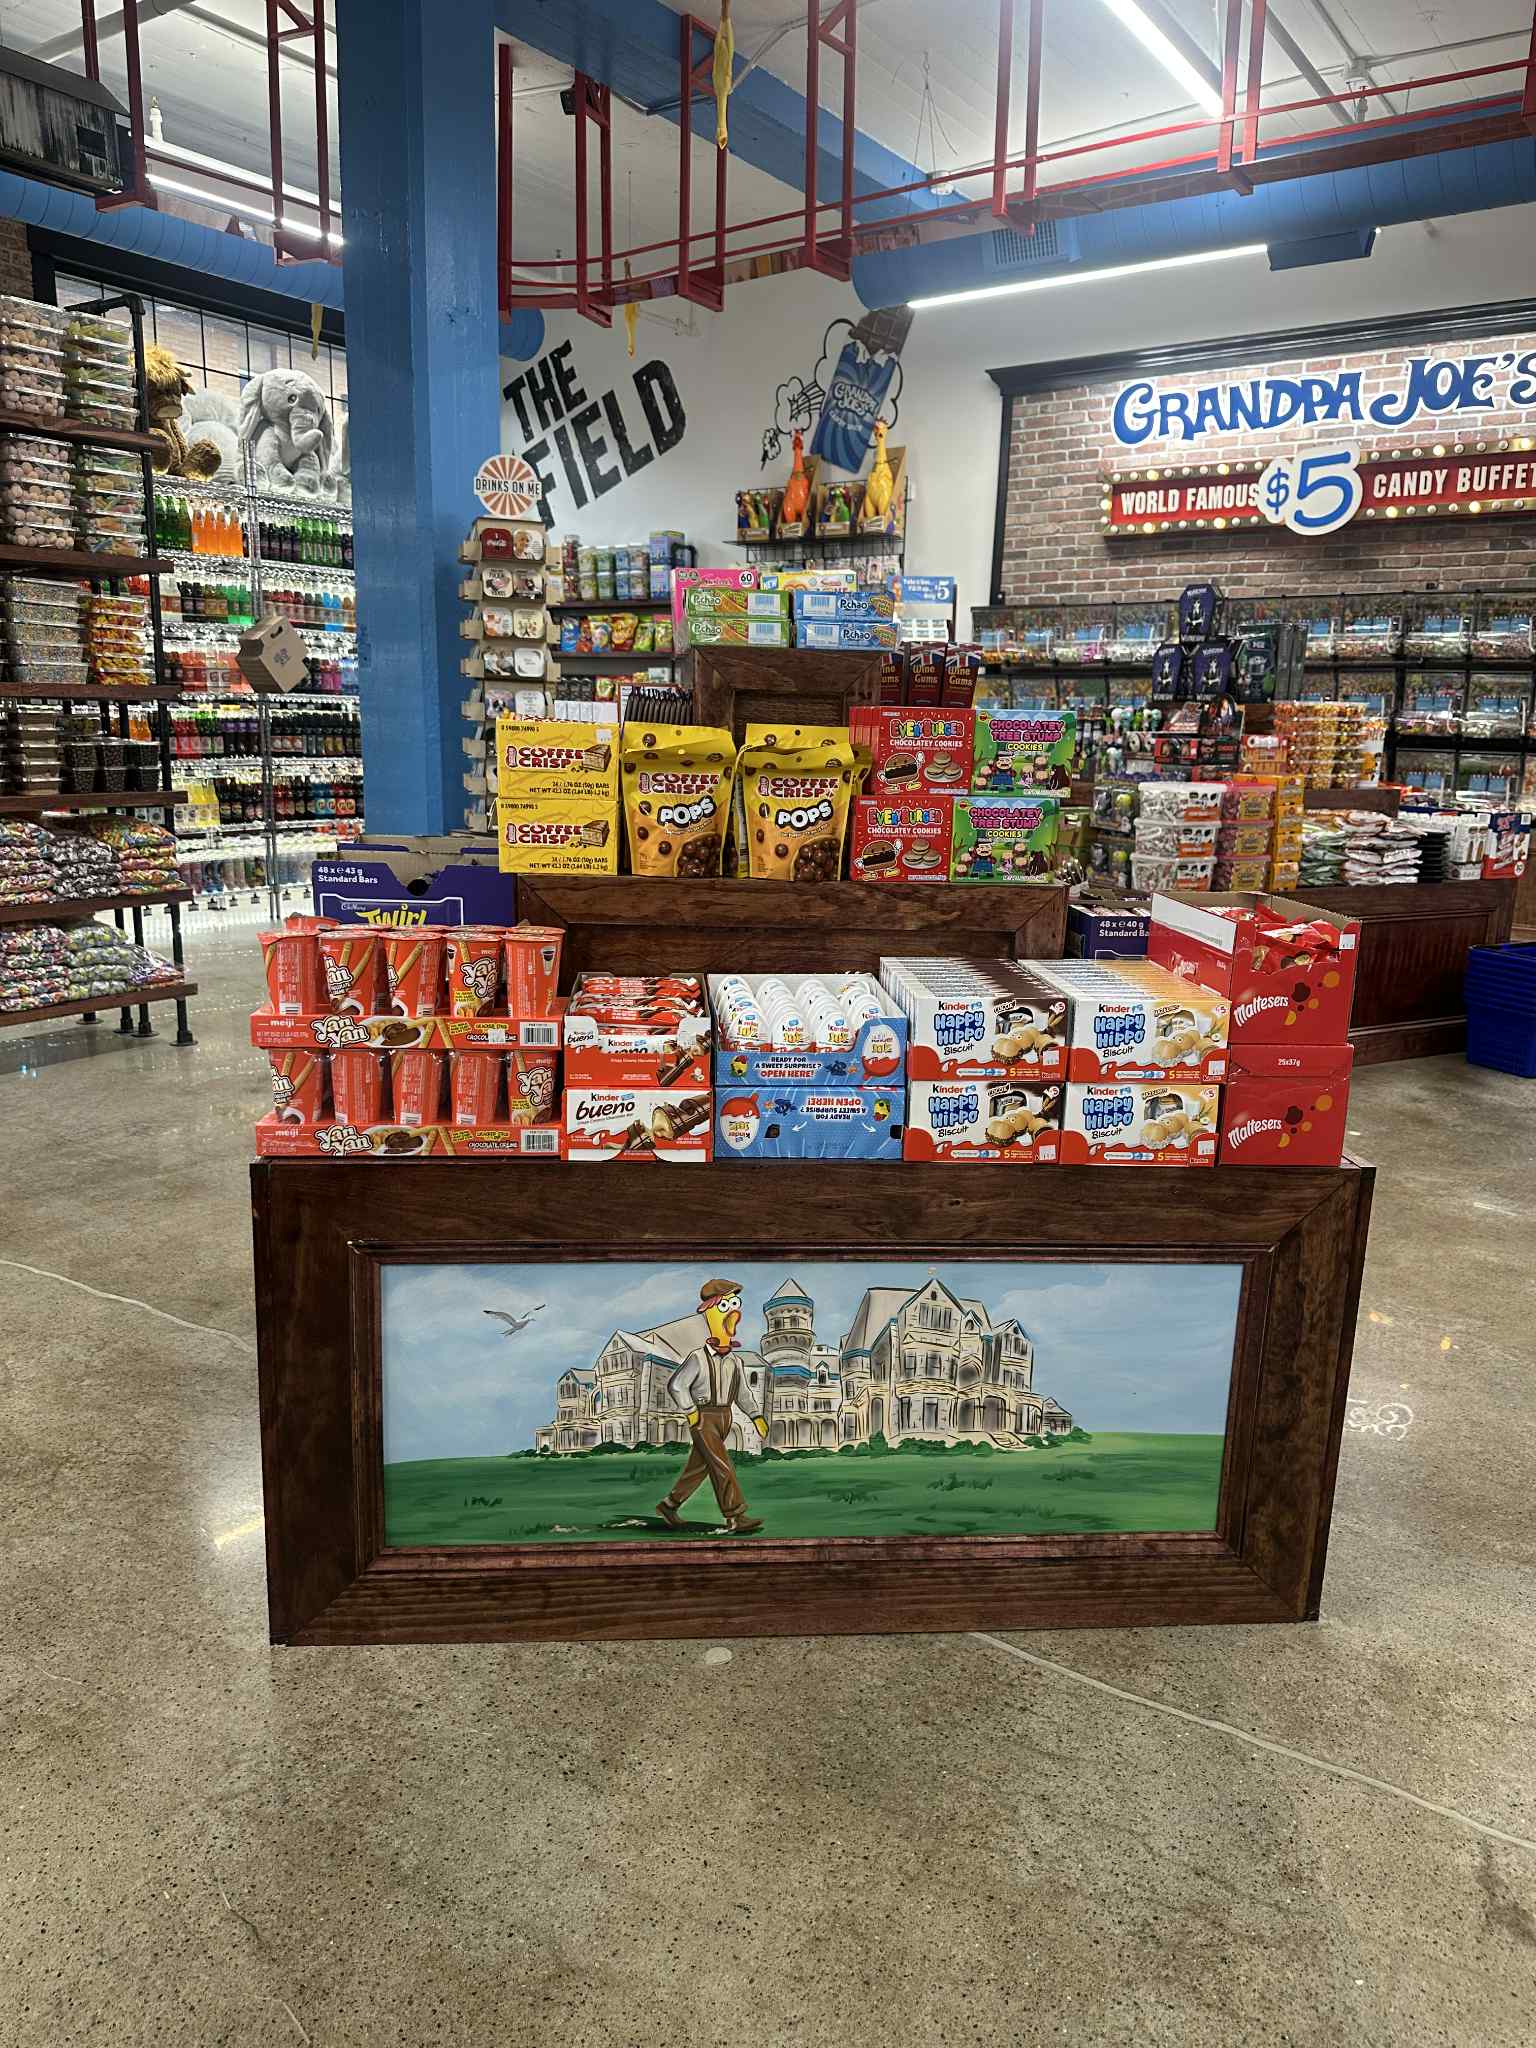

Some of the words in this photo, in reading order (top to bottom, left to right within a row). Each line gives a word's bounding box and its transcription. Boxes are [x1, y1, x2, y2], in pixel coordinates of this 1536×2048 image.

[503, 339, 587, 443] THE
[1113, 373, 1365, 444] GRANDPA
[1370, 352, 1536, 426] JOE'S
[521, 360, 686, 531] FIELD
[476, 479, 509, 492] DRINKS
[512, 481, 524, 493] ON
[528, 482, 540, 495] ME
[1121, 489, 1180, 515] WORLD
[1186, 483, 1259, 512] FAMOUS
[1265, 451, 1351, 528] $5
[1373, 469, 1448, 498] CANDY
[1456, 461, 1536, 494] BUFFET
[741, 573, 752, 582] 60
[882, 665, 896, 673] ine
[912, 665, 935, 674] Wine
[948, 666, 971, 676] Wine
[881, 676, 900, 684] ums
[914, 675, 938, 684] Gums
[949, 676, 973, 686] Gums
[990, 720, 1063, 731] CHOCOLATEY
[992, 731, 1021, 742] TREE
[1023, 731, 1062, 742] STUMP
[519, 746, 583, 759] COFFEE
[519, 758, 571, 768] CRISP
[652, 772, 719, 785] COFFEE
[771, 777, 839, 789] COFFEE
[652, 783, 706, 794] CRISP
[771, 787, 826, 798] CRISP
[660, 797, 715, 825] POPS
[778, 801, 832, 828] POPS
[969, 808, 1041, 819] CHOCOLATEY
[518, 824, 582, 835] COFFEE
[971, 818, 1001, 829] TREE
[1002, 819, 1040, 830] STUMP
[518, 834, 570, 844] CRISP
[357, 868, 363, 876] g
[318, 875, 358, 884] Standard
[359, 876, 378, 884] Bars
[355, 904, 428, 928] Twirl
[1099, 929, 1138, 937] Standard
[477, 972, 497, 997] Ya
[1233, 995, 1289, 1027] Maltesers
[270, 1019, 295, 1028] meiji
[934, 1011, 984, 1030] Happy
[1094, 1014, 1145, 1033] Happy
[312, 1016, 353, 1042] Yan
[331, 1026, 368, 1048] Yan
[568, 1033, 594, 1044] bueno
[937, 1027, 985, 1046] Hippo
[1097, 1030, 1145, 1049] Hippo
[944, 1043, 974, 1055] Biscuit
[1103, 1046, 1134, 1058] Biscuit
[1278, 1058, 1301, 1067] 25x37g
[760, 1070, 789, 1078] OPEN
[790, 1070, 814, 1078] HERE!
[1009, 1068, 1016, 1077] 5
[1169, 1070, 1175, 1079] 5
[530, 1080, 553, 1106] Ya
[807, 1097, 837, 1106] HERE!
[838, 1098, 861, 1106] OPEN
[928, 1094, 978, 1113] Happy
[1083, 1096, 1133, 1114] Happy
[576, 1101, 635, 1120] bueno
[932, 1110, 979, 1128] Hippo
[1085, 1112, 1133, 1130] Hippo
[275, 1129, 299, 1138] meiji
[315, 1125, 355, 1150] Yan
[938, 1126, 969, 1138] Biscuit
[1092, 1128, 1122, 1139] Biscuit
[1228, 1118, 1282, 1149] Maltesers
[335, 1136, 370, 1156] Yan
[1004, 1150, 1010, 1159] 5
[1157, 1152, 1164, 1161] 5
